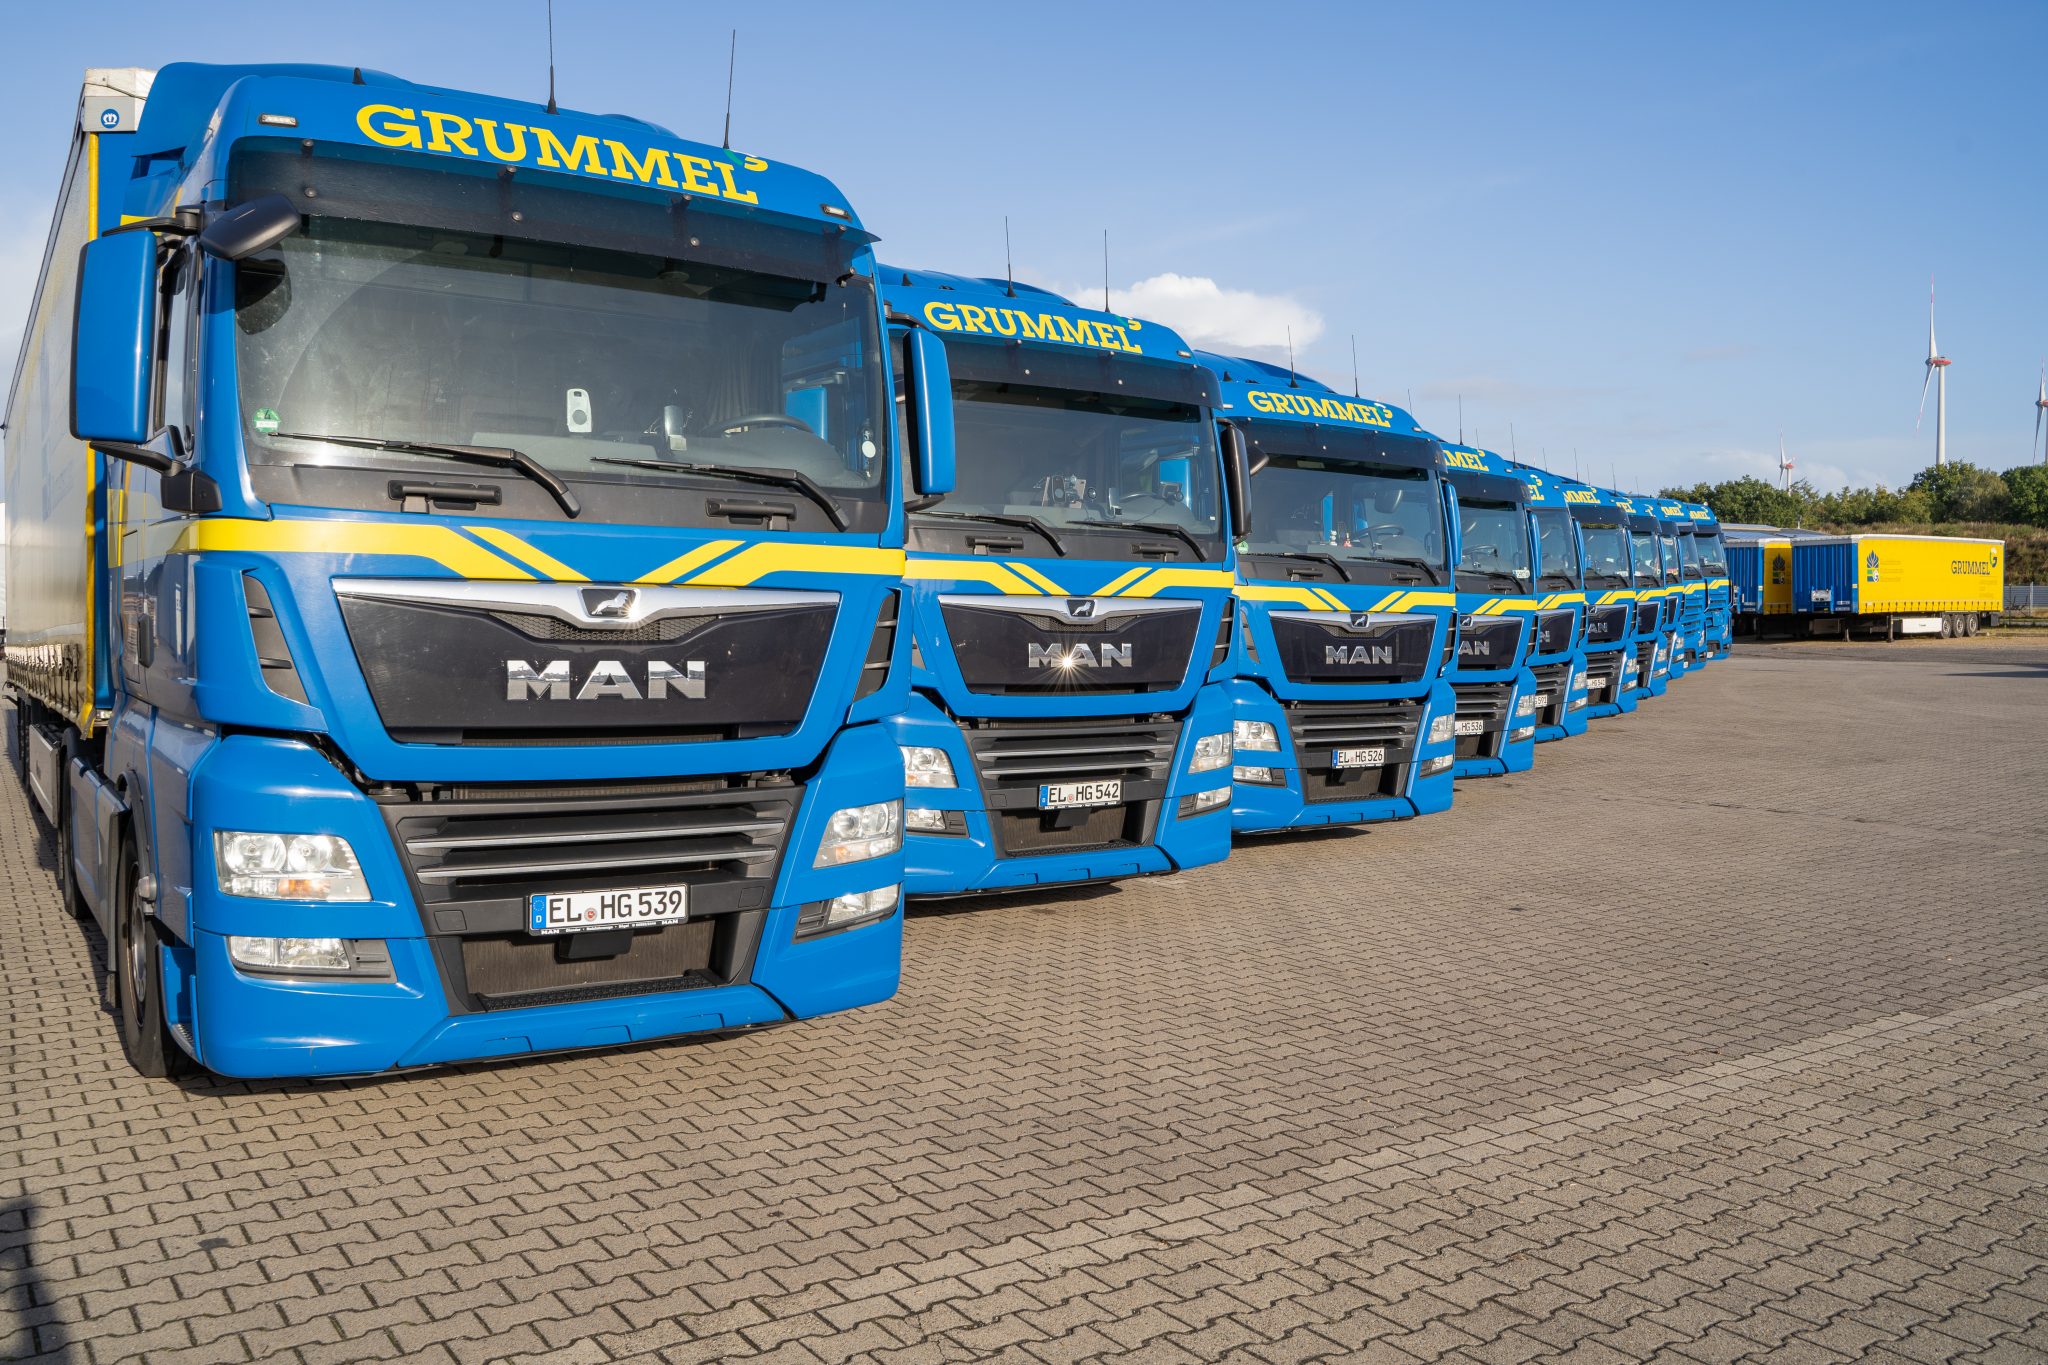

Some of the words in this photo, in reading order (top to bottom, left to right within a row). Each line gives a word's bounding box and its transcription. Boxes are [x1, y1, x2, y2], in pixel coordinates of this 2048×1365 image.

[356, 103, 759, 205] GRUMMEL
[923, 301, 1143, 355] GRUMMEL
[1247, 390, 1391, 428] GRUMMEL
[1951, 560, 1991, 575] GRUMMEL
[1028, 642, 1132, 668] MAN
[1325, 645, 1393, 665] MAN
[507, 660, 706, 700] MAN
[1338, 751, 1349, 763] EL
[1355, 750, 1366, 763] HG
[1367, 750, 1383, 762] 526
[1049, 787, 1066, 803] EL
[1076, 785, 1093, 801] HG
[1095, 783, 1119, 799] 542
[549, 897, 582, 924] EL
[600, 893, 632, 919] HG
[638, 890, 682, 917] 539
